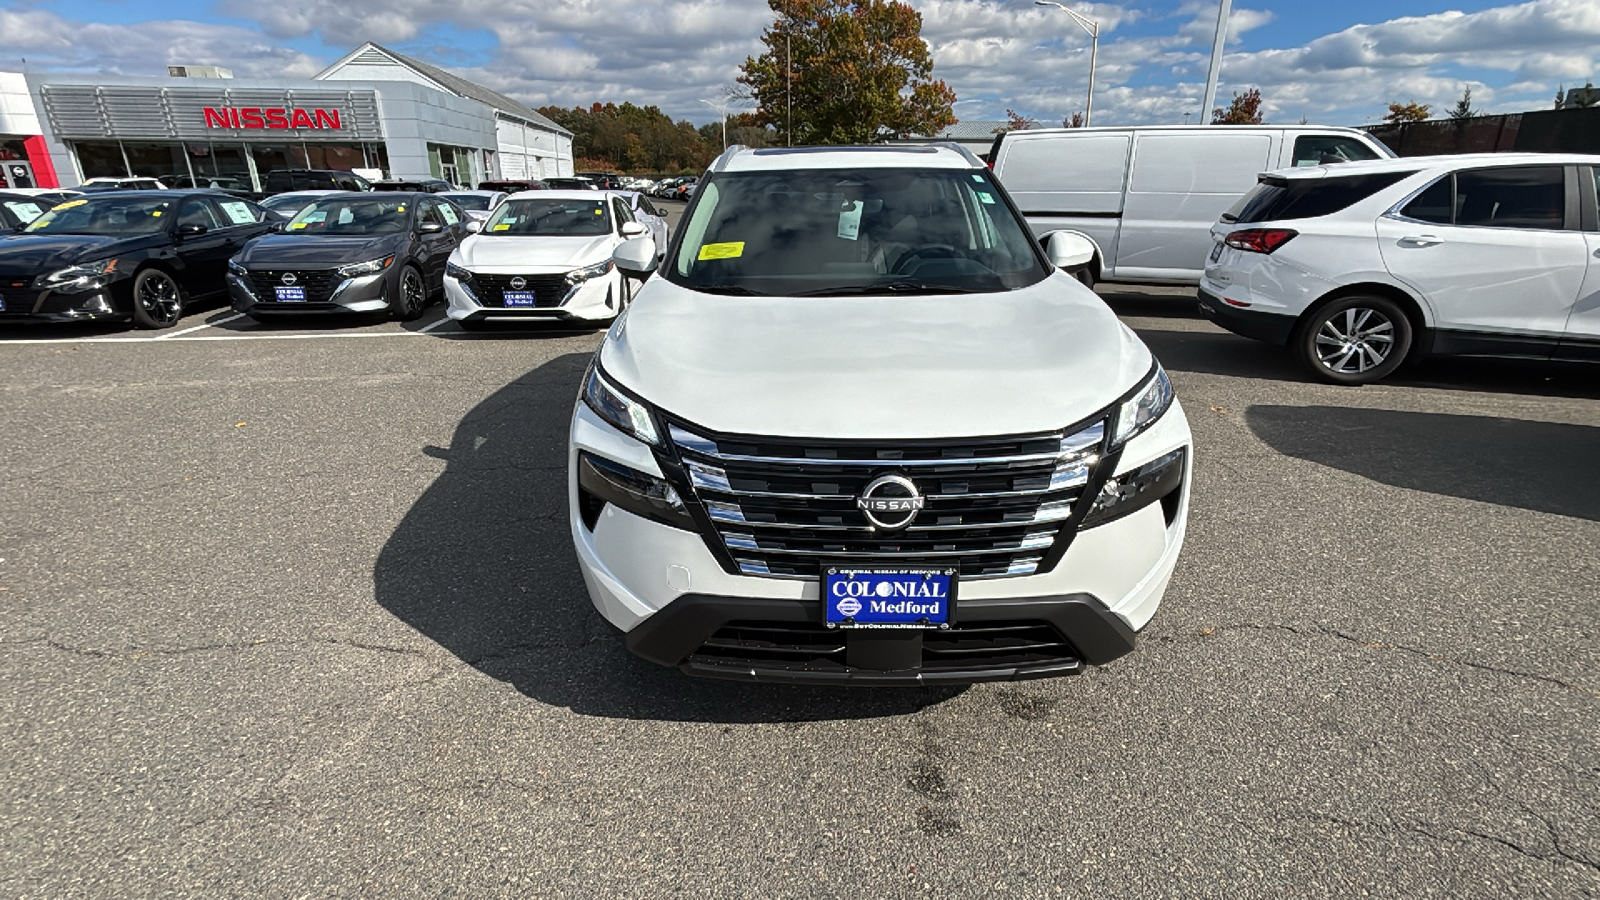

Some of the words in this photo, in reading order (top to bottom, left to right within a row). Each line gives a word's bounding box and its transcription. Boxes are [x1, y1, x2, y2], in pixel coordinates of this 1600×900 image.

[203, 107, 342, 130] NISSAN
[857, 499, 924, 510] NISSAN
[832, 581, 946, 597] COLONIAL
[869, 601, 940, 614] Medford
